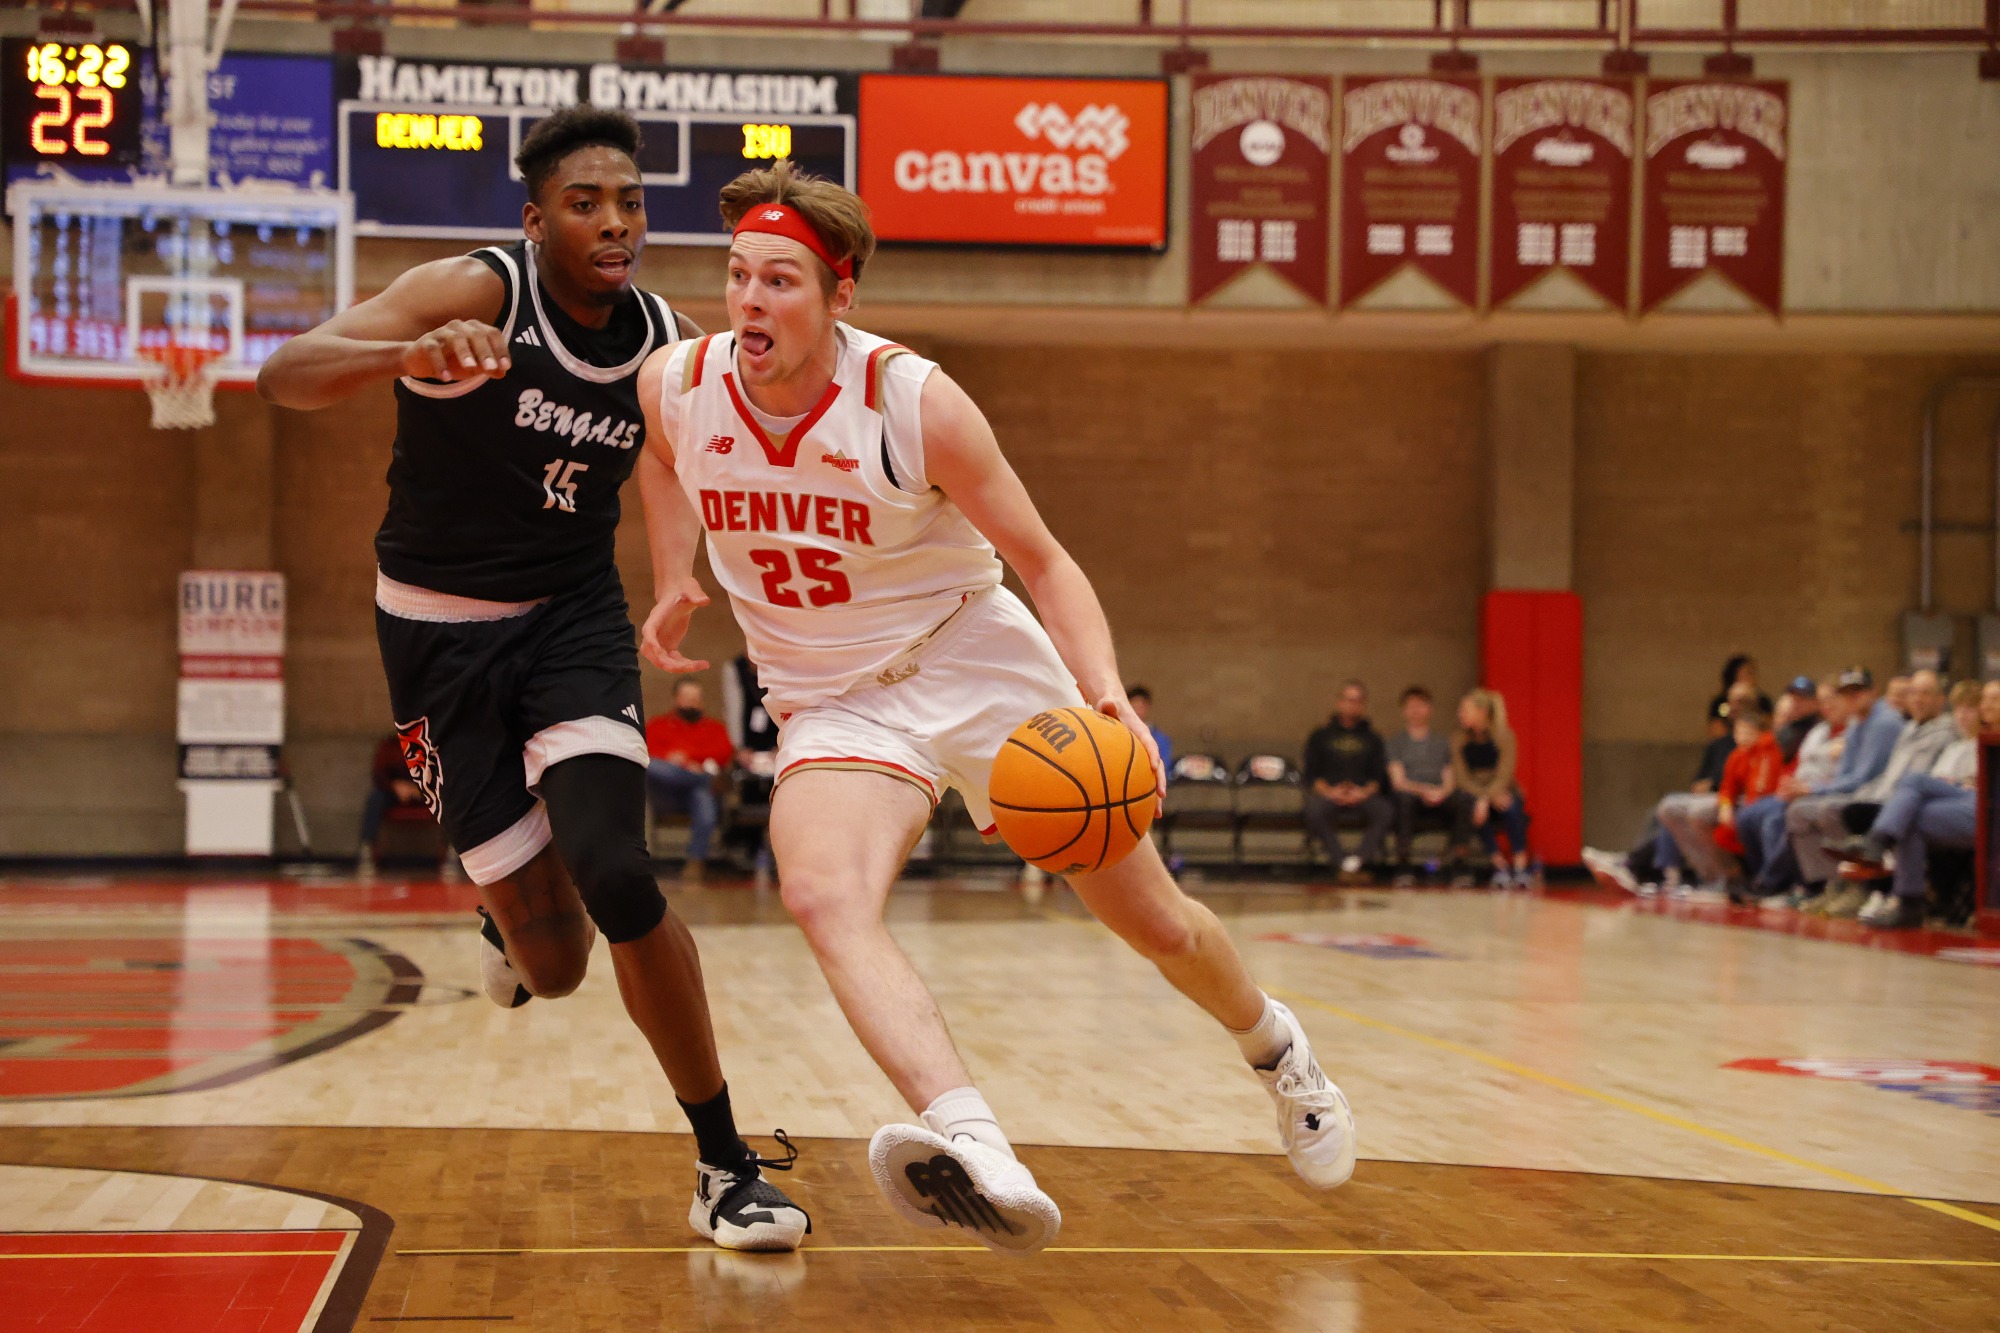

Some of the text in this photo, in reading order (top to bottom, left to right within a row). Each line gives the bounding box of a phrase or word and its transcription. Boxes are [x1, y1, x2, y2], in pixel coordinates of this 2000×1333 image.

[27, 43, 130, 88] 16:22
[358, 55, 838, 114] HAMILTON GYMNASIUM
[32, 84, 113, 155] 22
[376, 112, 483, 150] DENVER
[894, 150, 1109, 194] canvas
[514, 388, 641, 450] BENGALS
[542, 458, 590, 513] 15
[699, 488, 876, 547] DENVER
[183, 582, 280, 615] BURG
[748, 547, 852, 608] 25
